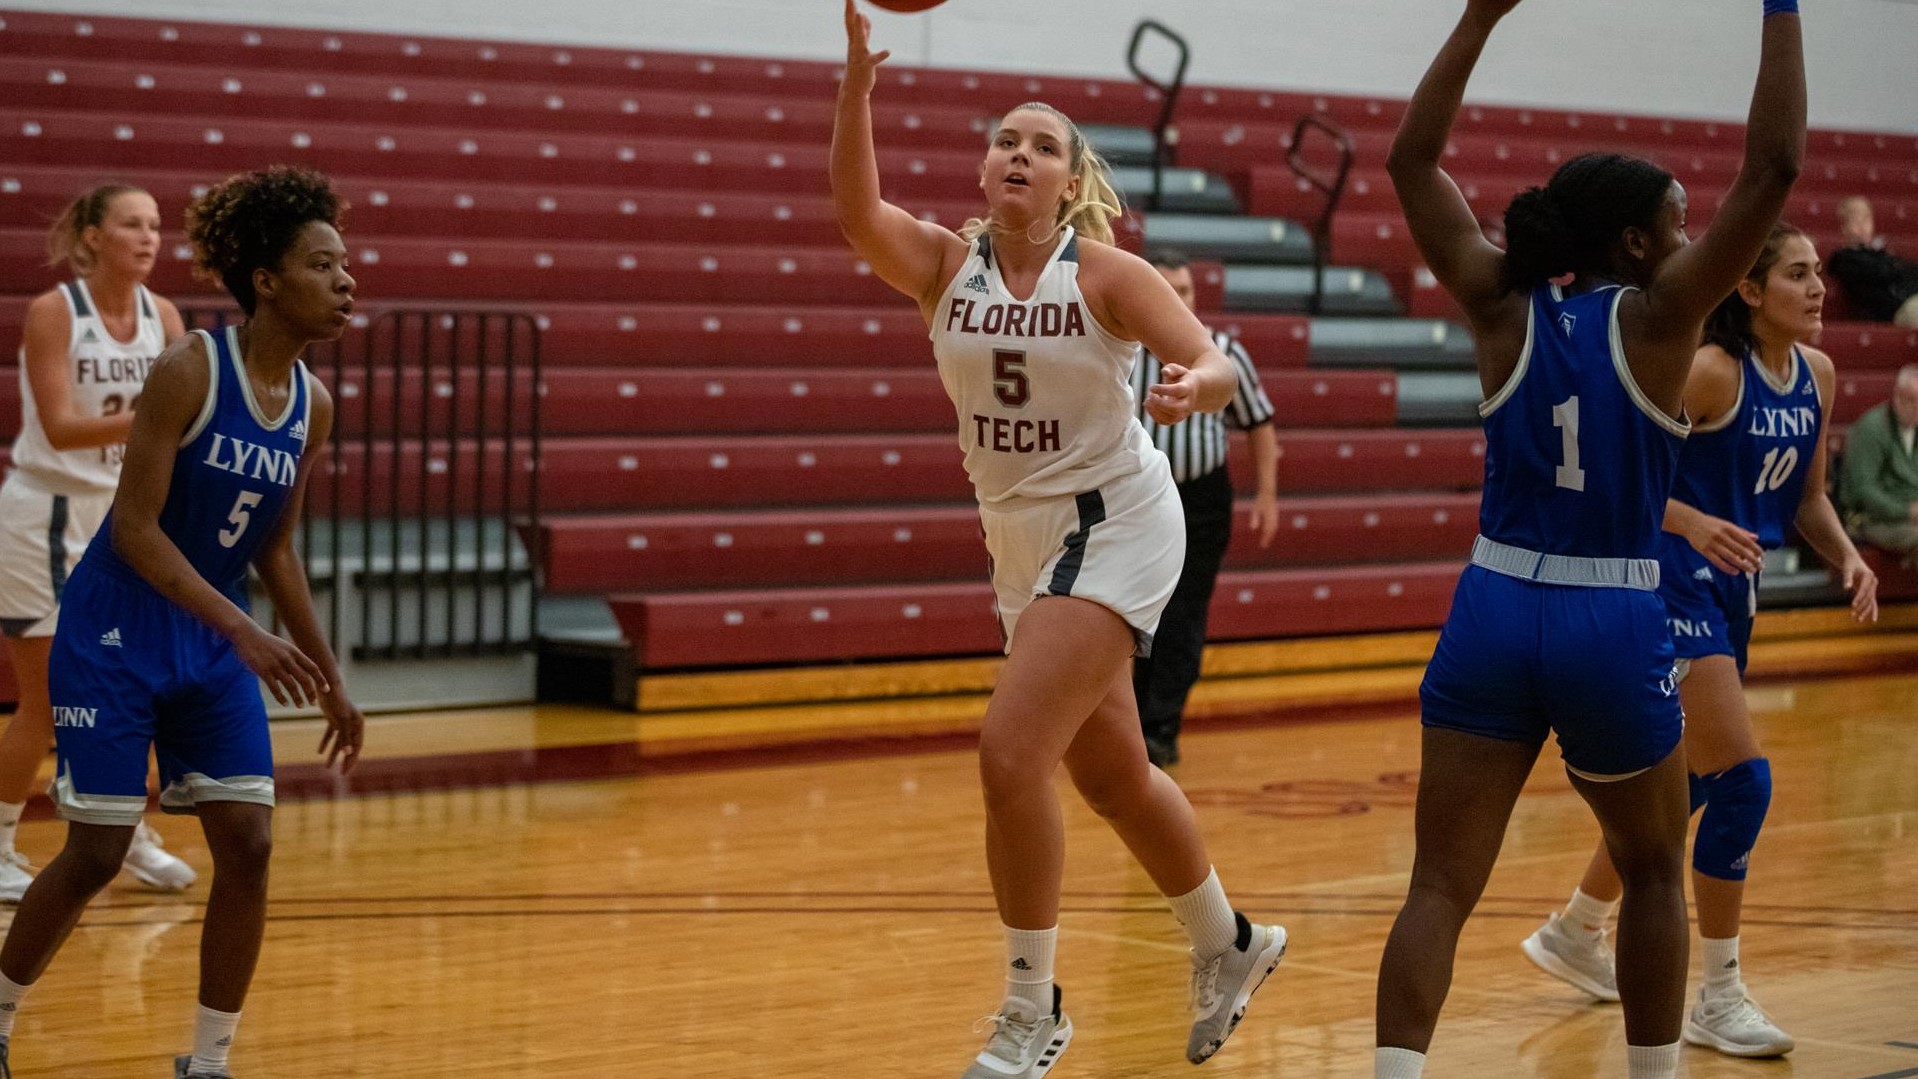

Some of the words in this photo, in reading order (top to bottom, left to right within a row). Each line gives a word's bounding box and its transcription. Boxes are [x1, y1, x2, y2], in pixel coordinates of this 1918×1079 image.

[947, 298, 1086, 337] FLORIDA
[992, 348, 1031, 410] 5
[973, 414, 1062, 453] TECH
[1552, 395, 1585, 492] 1
[1748, 404, 1816, 438] LYNN
[203, 432, 300, 487] LYNN
[1753, 446, 1799, 495] 10
[218, 490, 264, 548] 5
